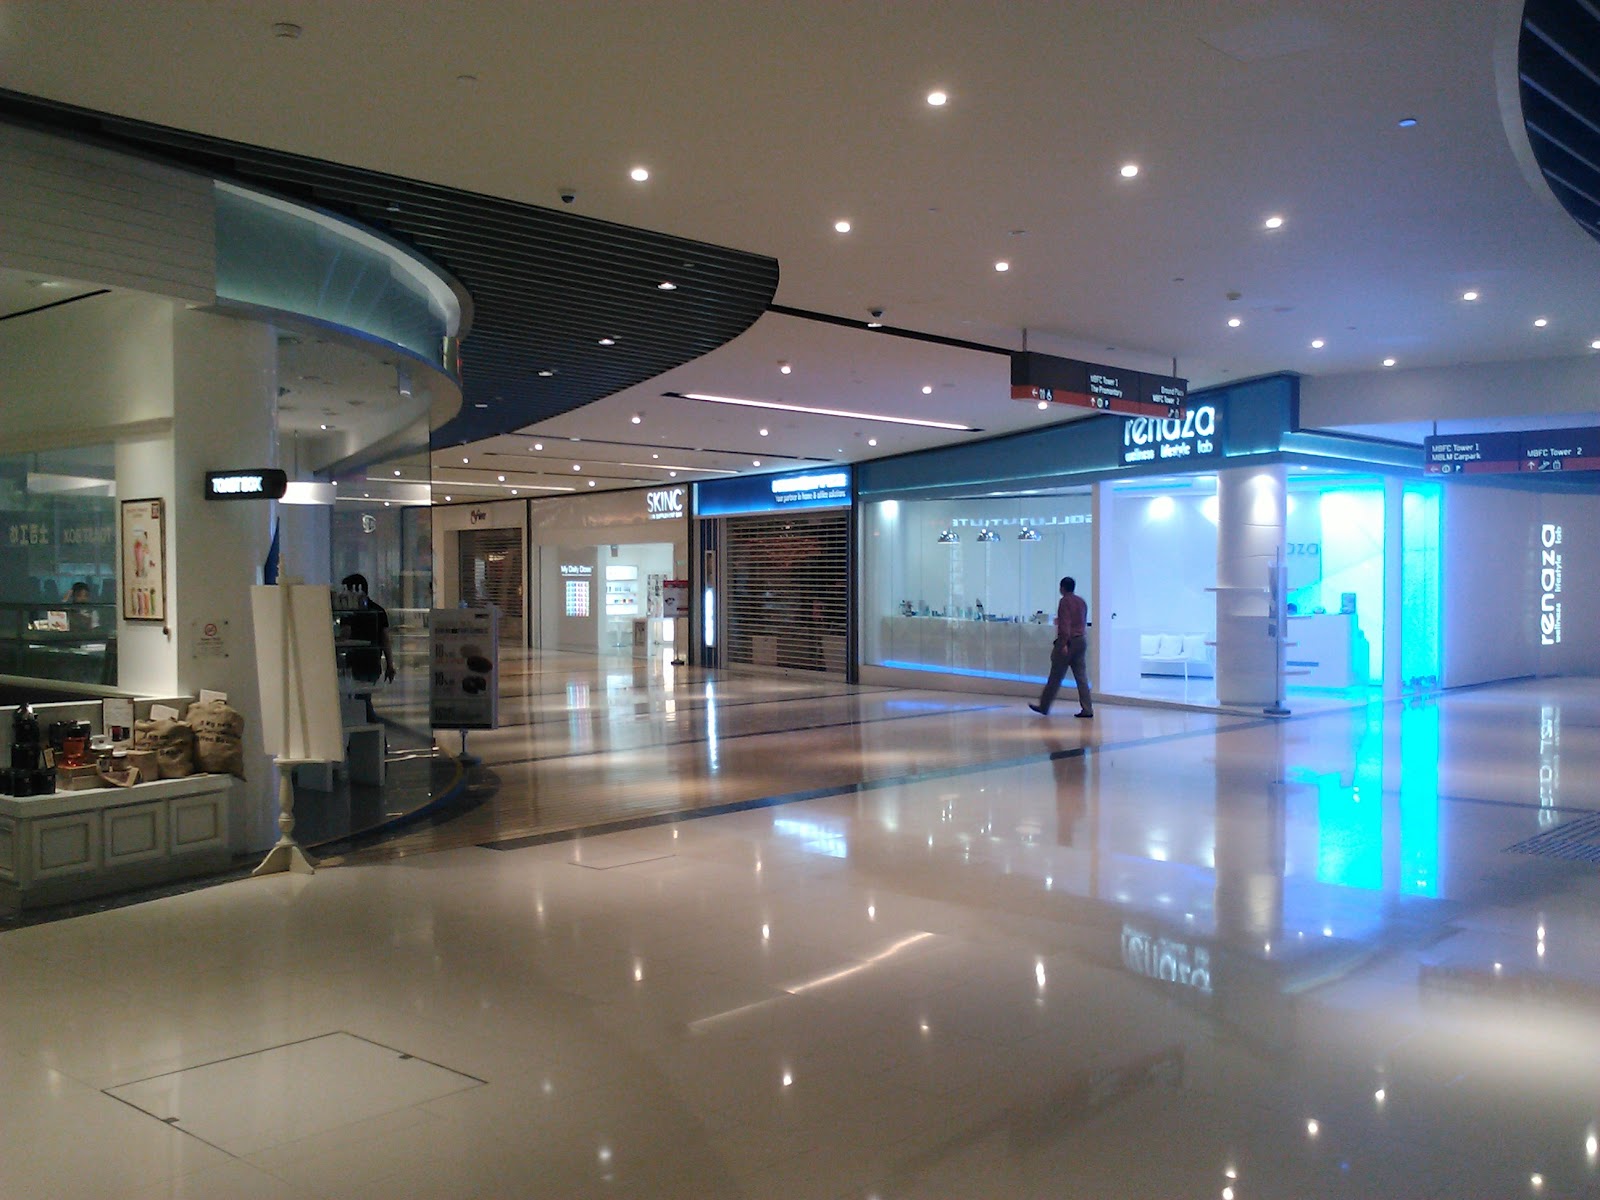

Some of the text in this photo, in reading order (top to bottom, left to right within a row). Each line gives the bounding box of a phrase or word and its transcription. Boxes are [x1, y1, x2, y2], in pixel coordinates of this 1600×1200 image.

[1197, 440, 1213, 454] lab
[1431, 444, 1452, 452] MBFC
[1453, 444, 1474, 452] Tower
[1526, 447, 1583, 457] MBFC Tower 2
[1453, 452, 1481, 461] Carpark
[1541, 524, 1555, 646] renaza
